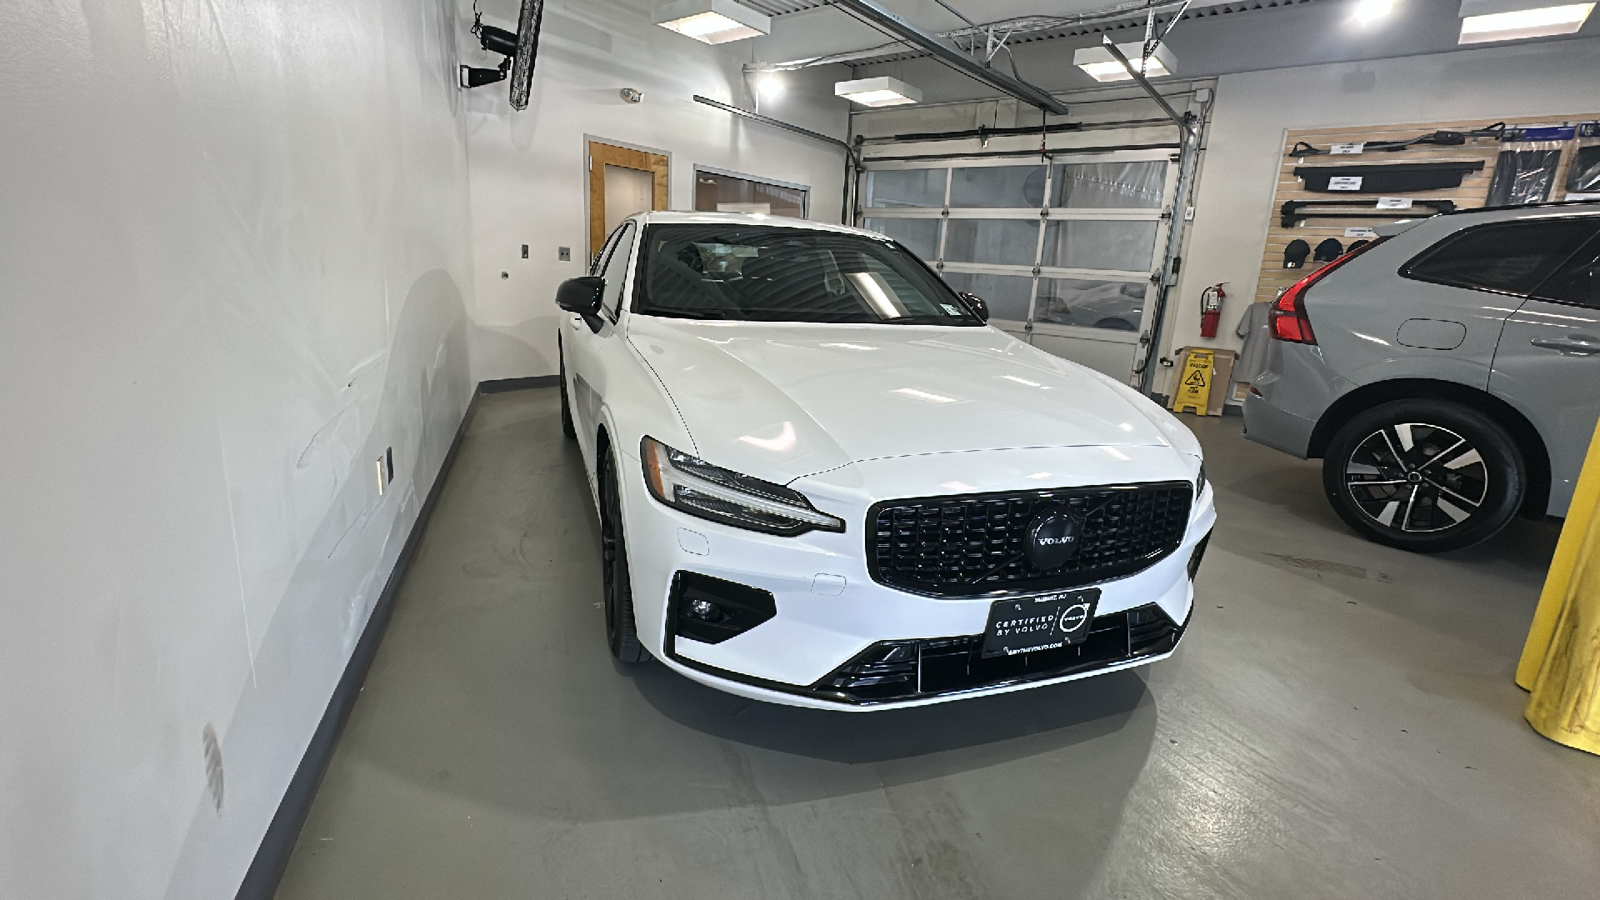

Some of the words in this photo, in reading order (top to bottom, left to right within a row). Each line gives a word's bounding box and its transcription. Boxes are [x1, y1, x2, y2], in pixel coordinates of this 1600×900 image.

[1038, 536, 1074, 546] VOLVO
[996, 614, 1054, 628] CERTIFIED
[996, 628, 1011, 636] BY
[1015, 622, 1049, 634] VOLVO
